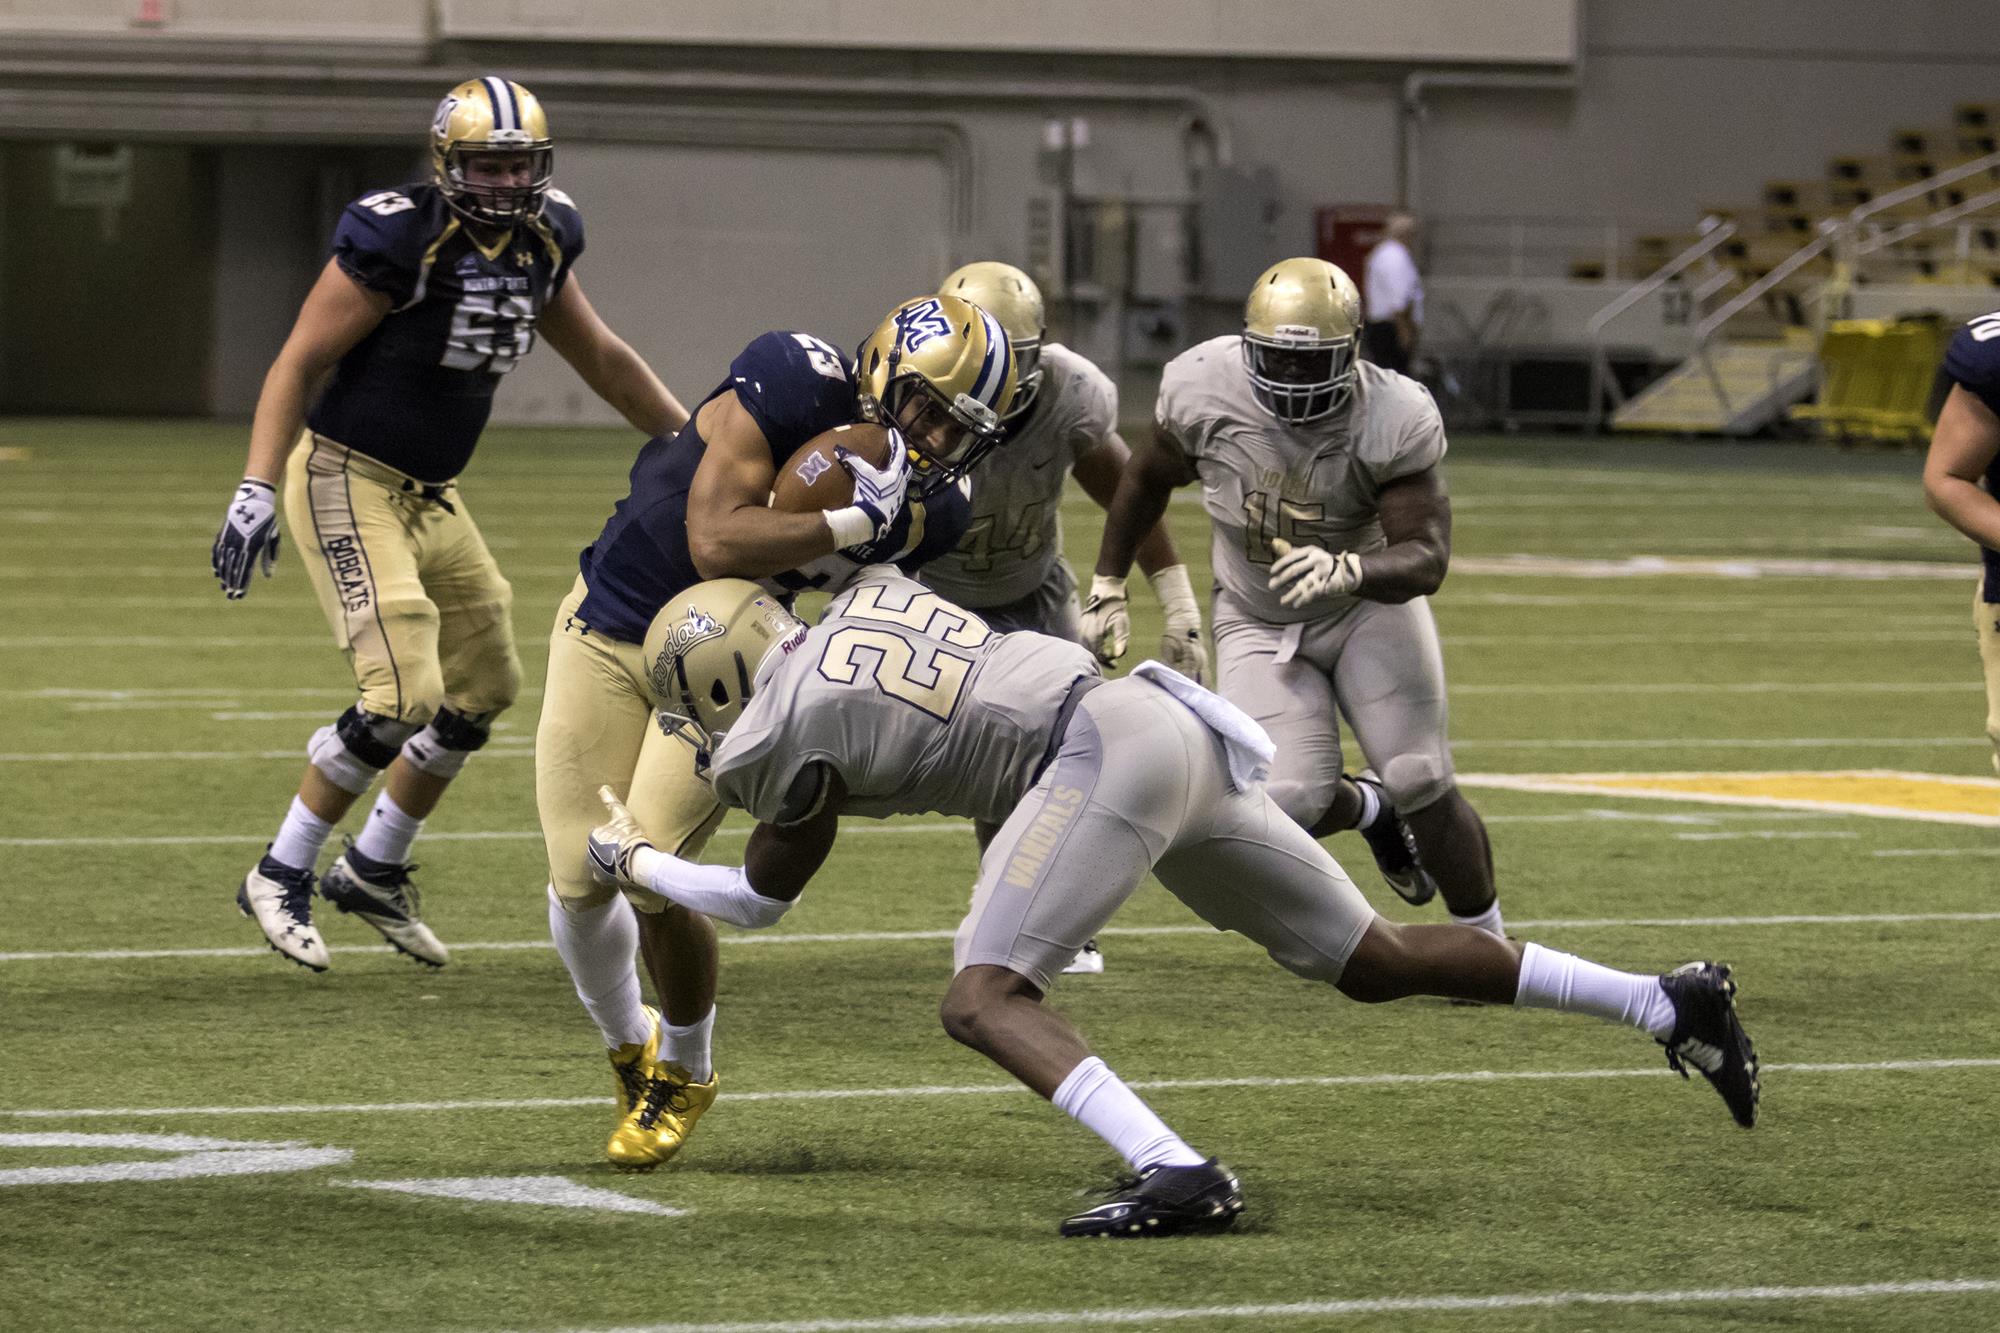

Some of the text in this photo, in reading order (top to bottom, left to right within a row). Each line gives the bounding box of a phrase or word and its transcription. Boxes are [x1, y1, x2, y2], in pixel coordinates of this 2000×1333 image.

[440, 295, 535, 373] 53
[796, 449, 833, 487] M
[328, 535, 369, 613] BOBCATS
[817, 584, 994, 725] 25
[1004, 784, 1084, 890] VANDALS
